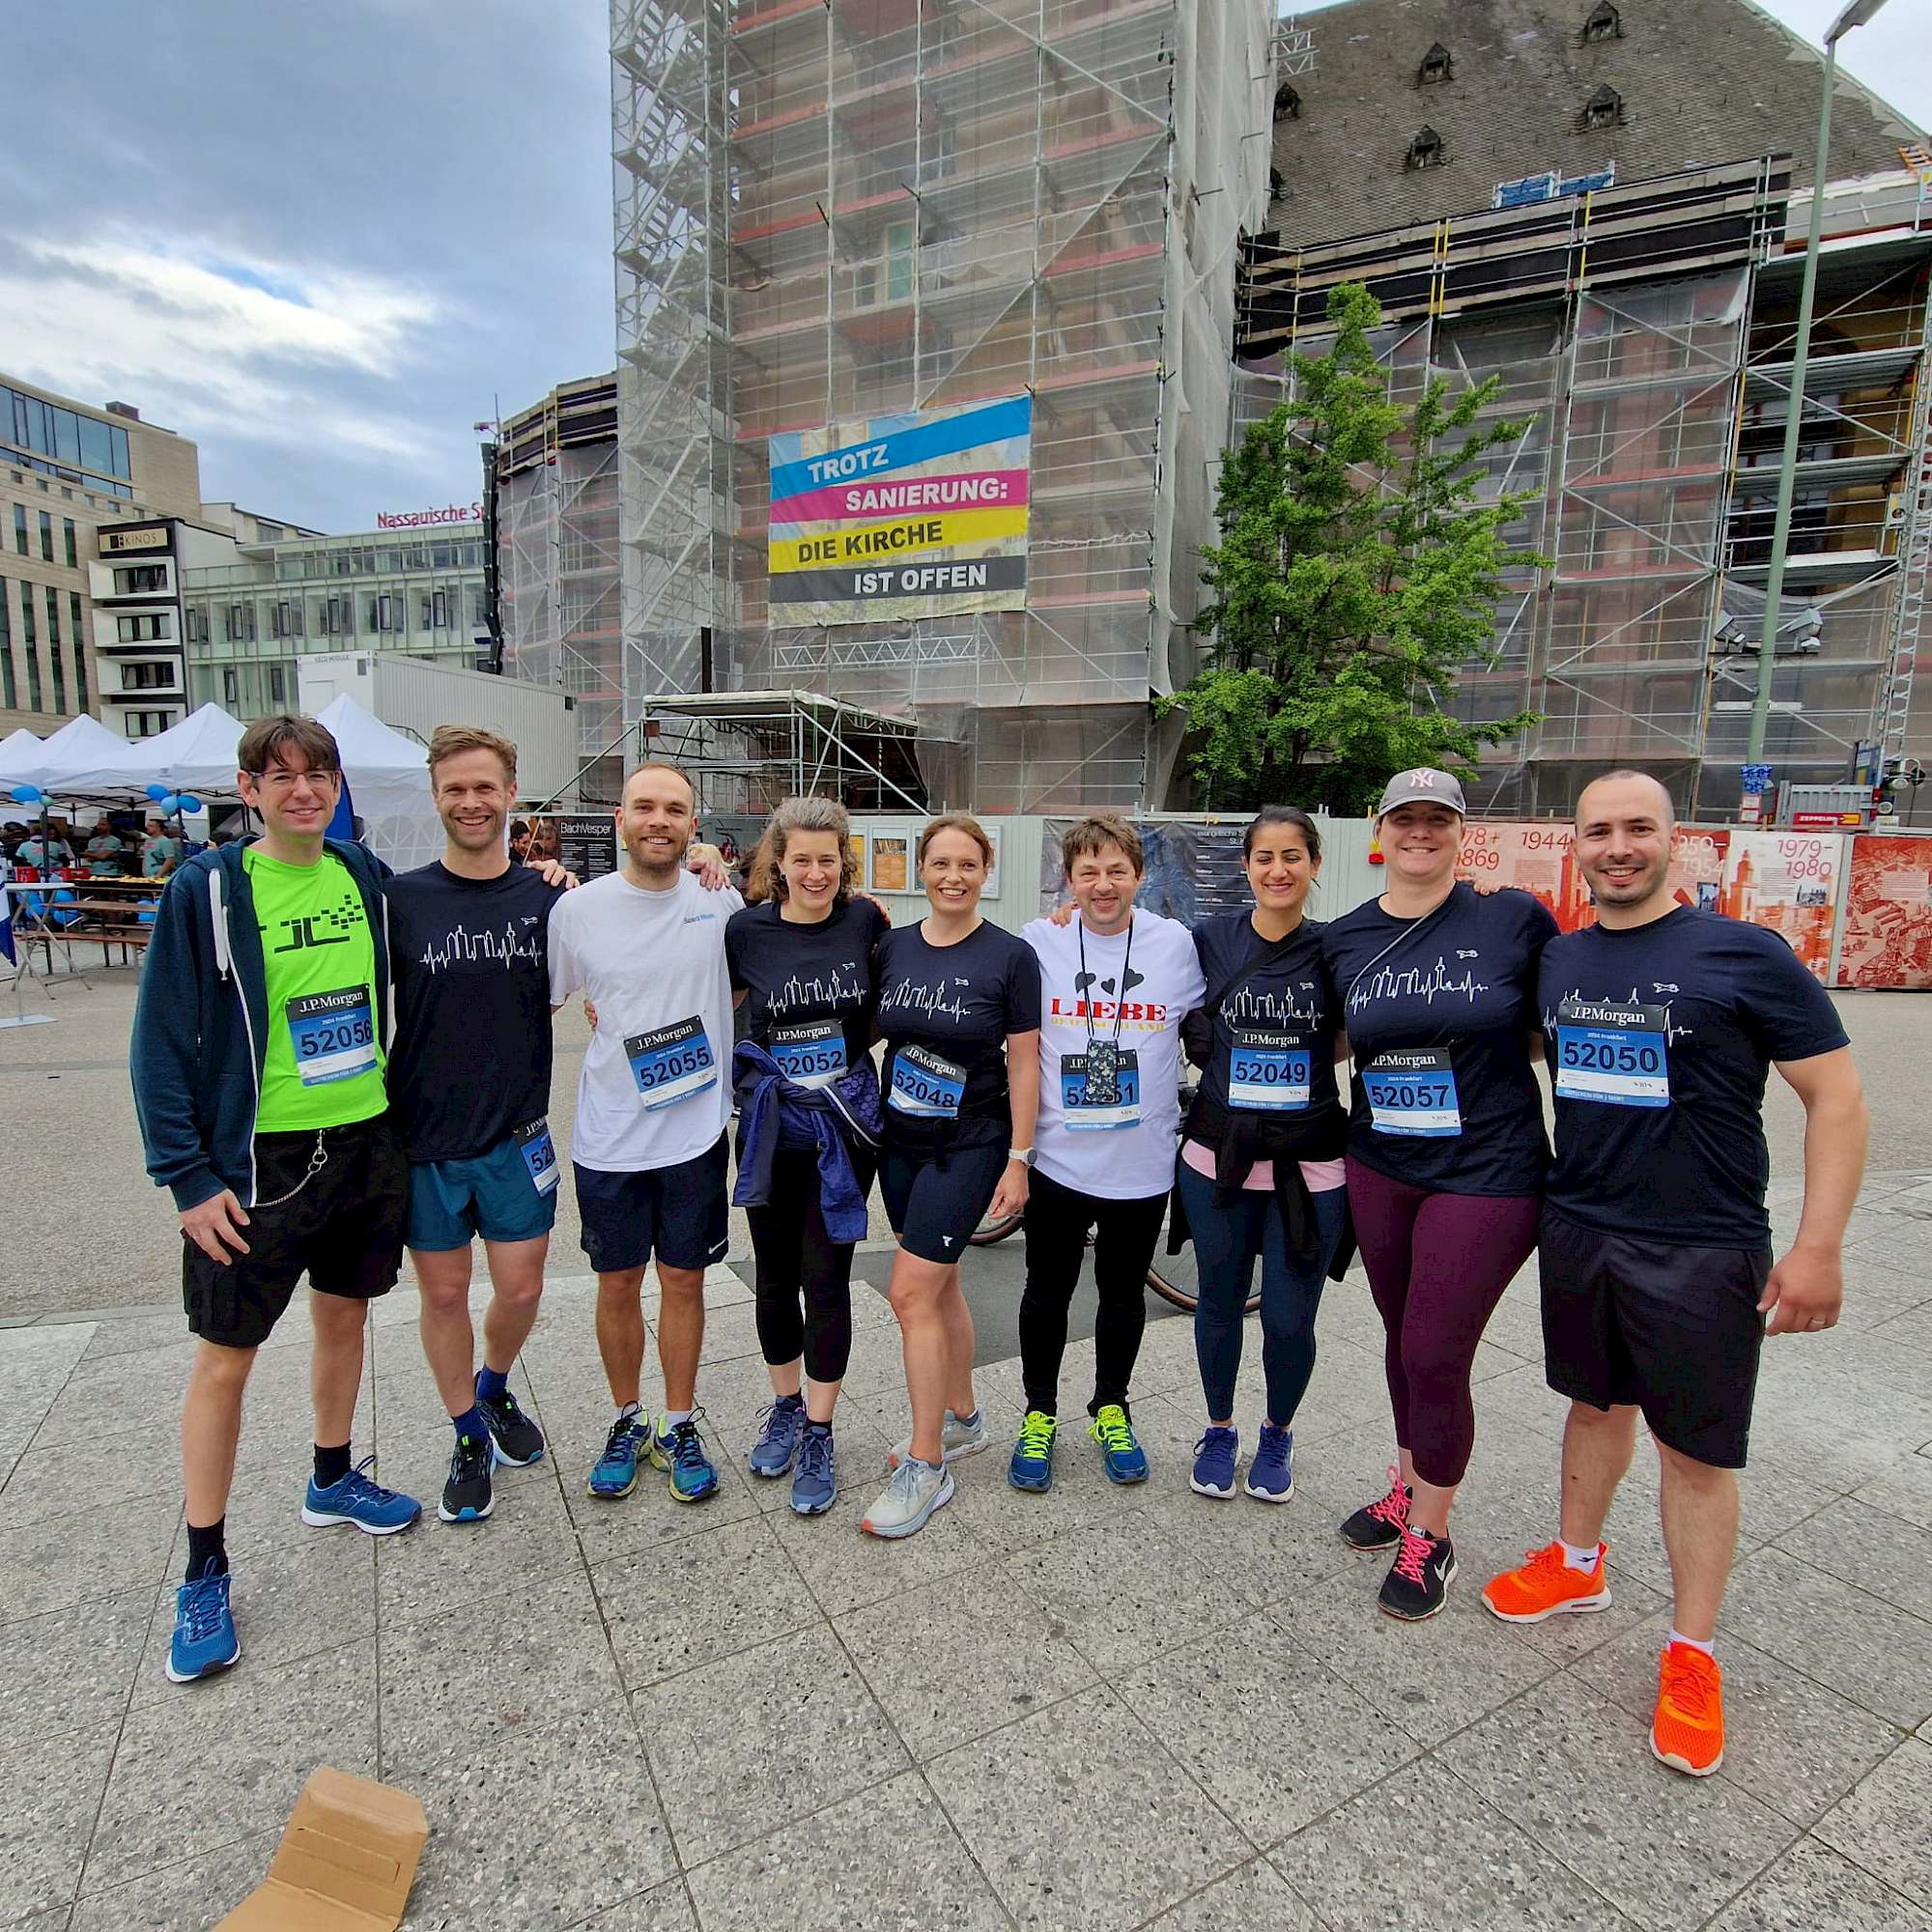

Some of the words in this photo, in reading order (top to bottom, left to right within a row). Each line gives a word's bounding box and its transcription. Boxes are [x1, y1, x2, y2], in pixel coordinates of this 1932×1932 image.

[808, 443, 889, 483] TROTZ
[845, 477, 1008, 512] SANIERUNG:
[378, 503, 468, 528] Nassauische
[798, 538, 838, 563] DIE
[845, 521, 943, 557] KIRCHE
[854, 571, 894, 594] IST
[900, 564, 987, 591] OFFEN
[1410, 771, 1434, 788] NY
[560, 821, 611, 837] BachVesper
[1520, 831, 1571, 851] 1944
[1455, 848, 1500, 871] 1869
[1682, 859, 1726, 879] 1954
[1786, 859, 1833, 880] 1980
[299, 990, 363, 1013] J.P.Morgan
[1051, 998, 1167, 1022] LIEBE
[1571, 1007, 1646, 1027] J.P.Morgan
[300, 1019, 372, 1056] 52056
[637, 1023, 694, 1050] J.P.Morgan
[776, 1026, 832, 1041] J.P.Morgan
[1242, 1033, 1300, 1048] J.P.Morgan
[640, 1046, 710, 1088] 52055
[777, 1050, 843, 1075] 52052
[906, 1047, 956, 1076] J.P.Morgan
[1372, 1055, 1436, 1069] J.P.Morgan
[1564, 1040, 1660, 1073] 52050
[1236, 1061, 1306, 1084] 52049
[895, 1068, 955, 1108] 52048
[1371, 1085, 1449, 1108] 52057
